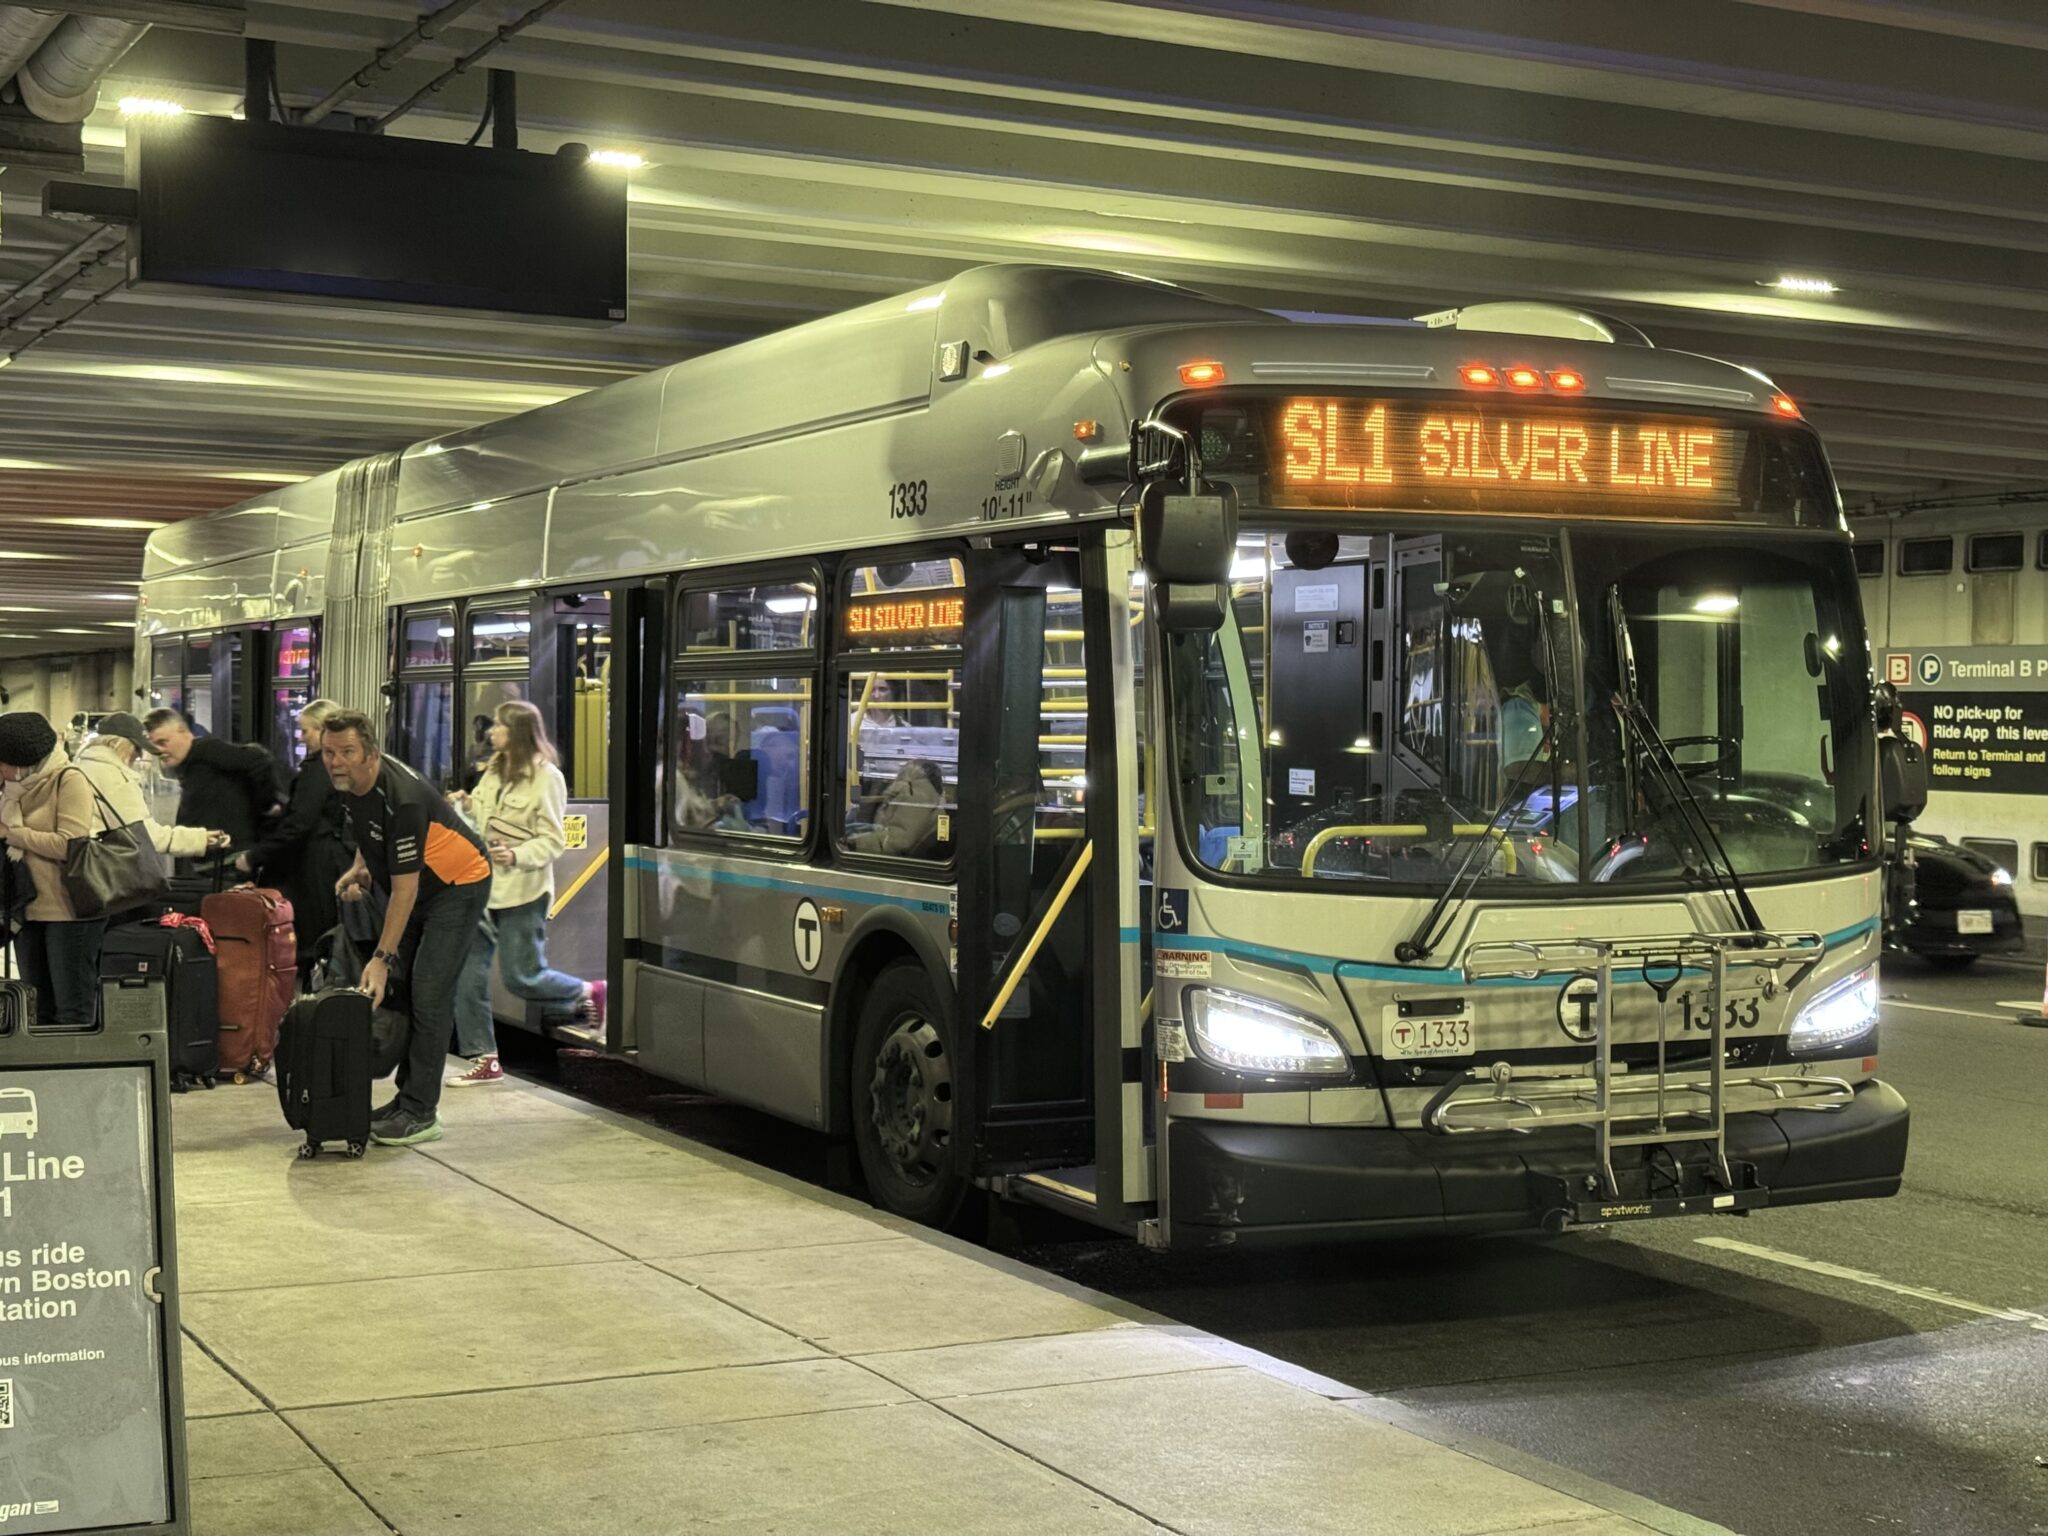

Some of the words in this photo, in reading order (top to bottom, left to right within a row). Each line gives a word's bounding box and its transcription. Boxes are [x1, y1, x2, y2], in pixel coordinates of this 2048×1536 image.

[1284, 402, 1392, 483] SL1
[1420, 418, 1588, 482] SILVER
[1611, 425, 1713, 487] LINE
[995, 478, 1020, 491] HEIGHT
[889, 480, 927, 519] 1333
[874, 603, 924, 631] SILVER
[928, 600, 964, 627] LINE
[1890, 659, 1907, 680] B
[1924, 660, 1938, 679] P
[1949, 661, 2014, 677] Terminal
[2020, 661, 2032, 677] B
[1934, 705, 1953, 719] NO
[1956, 706, 2001, 723] pick-up
[2005, 706, 2023, 720] for
[1934, 725, 1960, 739] Ride
[1963, 726, 1989, 742] App
[1996, 727, 2019, 740] this
[1933, 748, 1965, 760] Return
[1967, 749, 1978, 760] to
[1980, 750, 2023, 762] Terminal
[2026, 752, 2046, 763] and
[1933, 764, 1961, 776] follow
[1964, 766, 1991, 779] signs
[798, 918, 817, 962] T
[1161, 951, 1208, 962] WARNING
[1420, 1020, 1469, 1049] 1333
[3, 1151, 85, 1182] Line
[32, 1242, 85, 1266] ride
[32, 1269, 131, 1293] Boston
